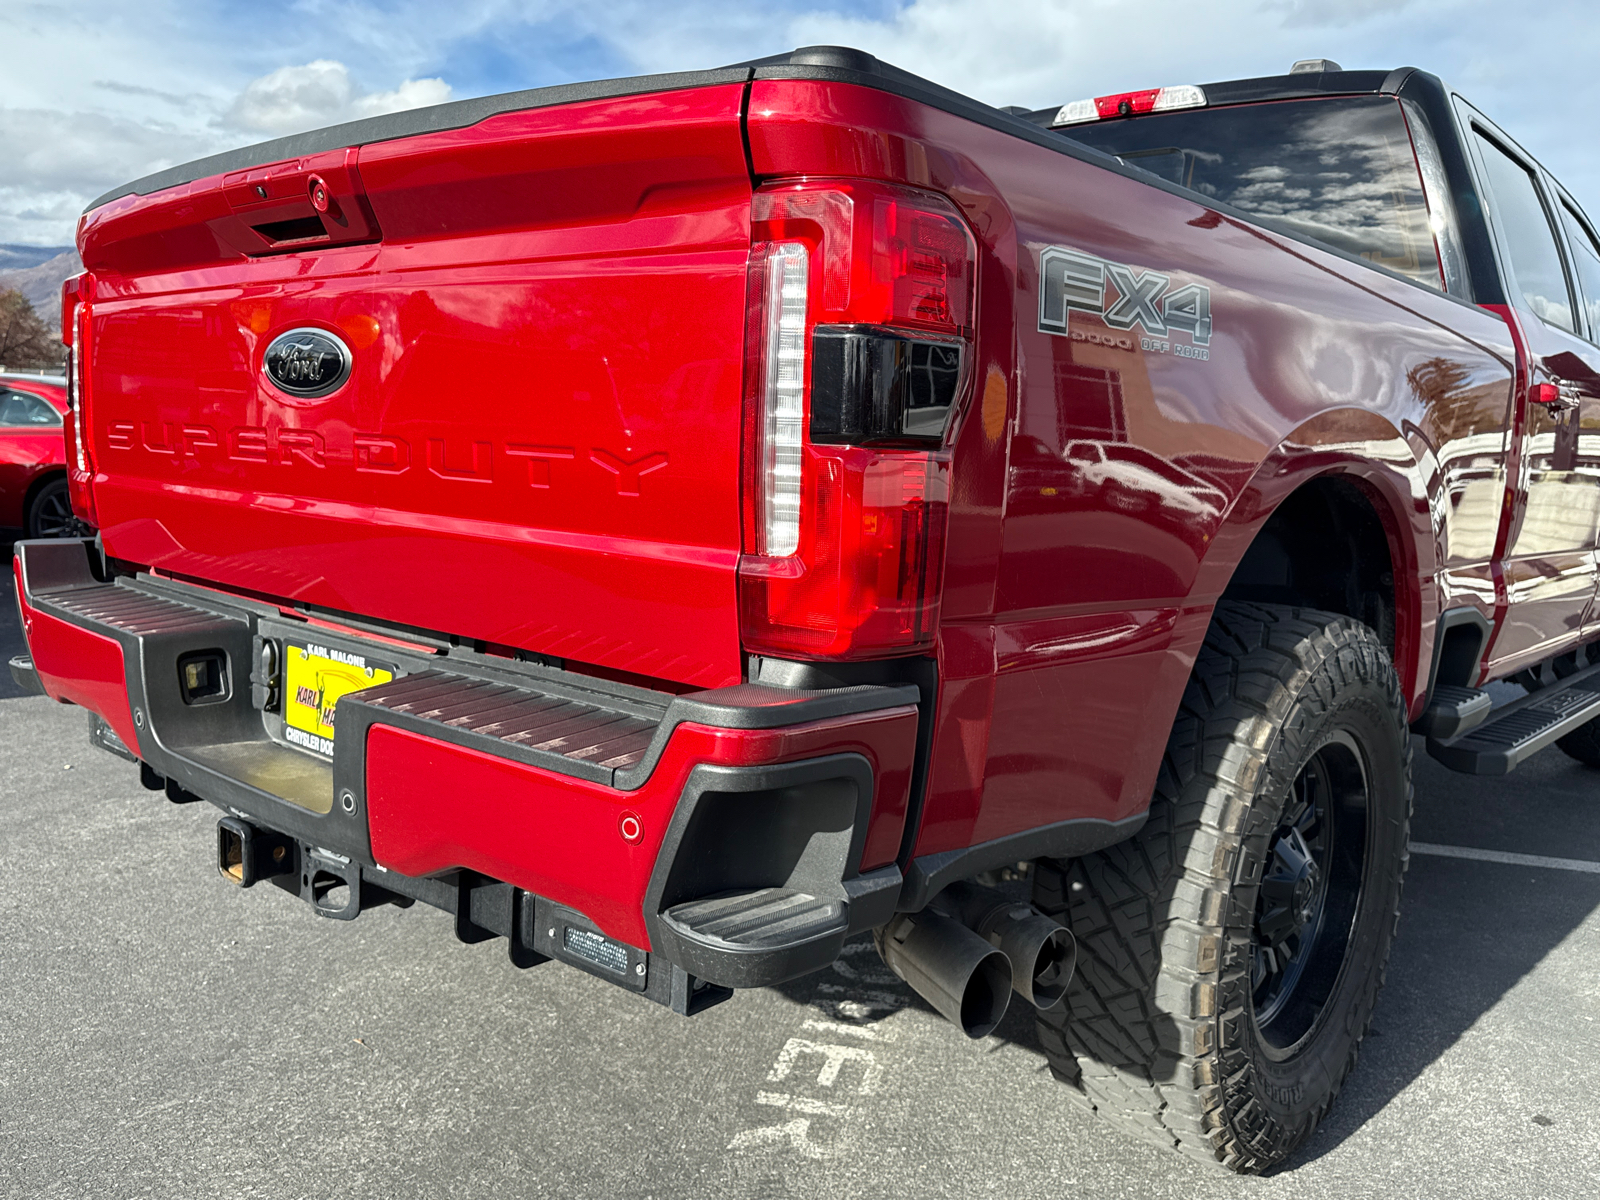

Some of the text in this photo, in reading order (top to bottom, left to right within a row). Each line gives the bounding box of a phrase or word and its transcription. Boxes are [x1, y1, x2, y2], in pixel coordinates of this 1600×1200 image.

[1037, 245, 1212, 346] FX4
[278, 342, 325, 381] Ford
[1141, 338, 1170, 353] OFF
[1174, 345, 1210, 361] ROAD
[107, 420, 669, 497] SUPER DUTY
[307, 643, 366, 668] KARL MALONE
[295, 685, 318, 709] KARL
[286, 727, 320, 752] CHRYSLER
